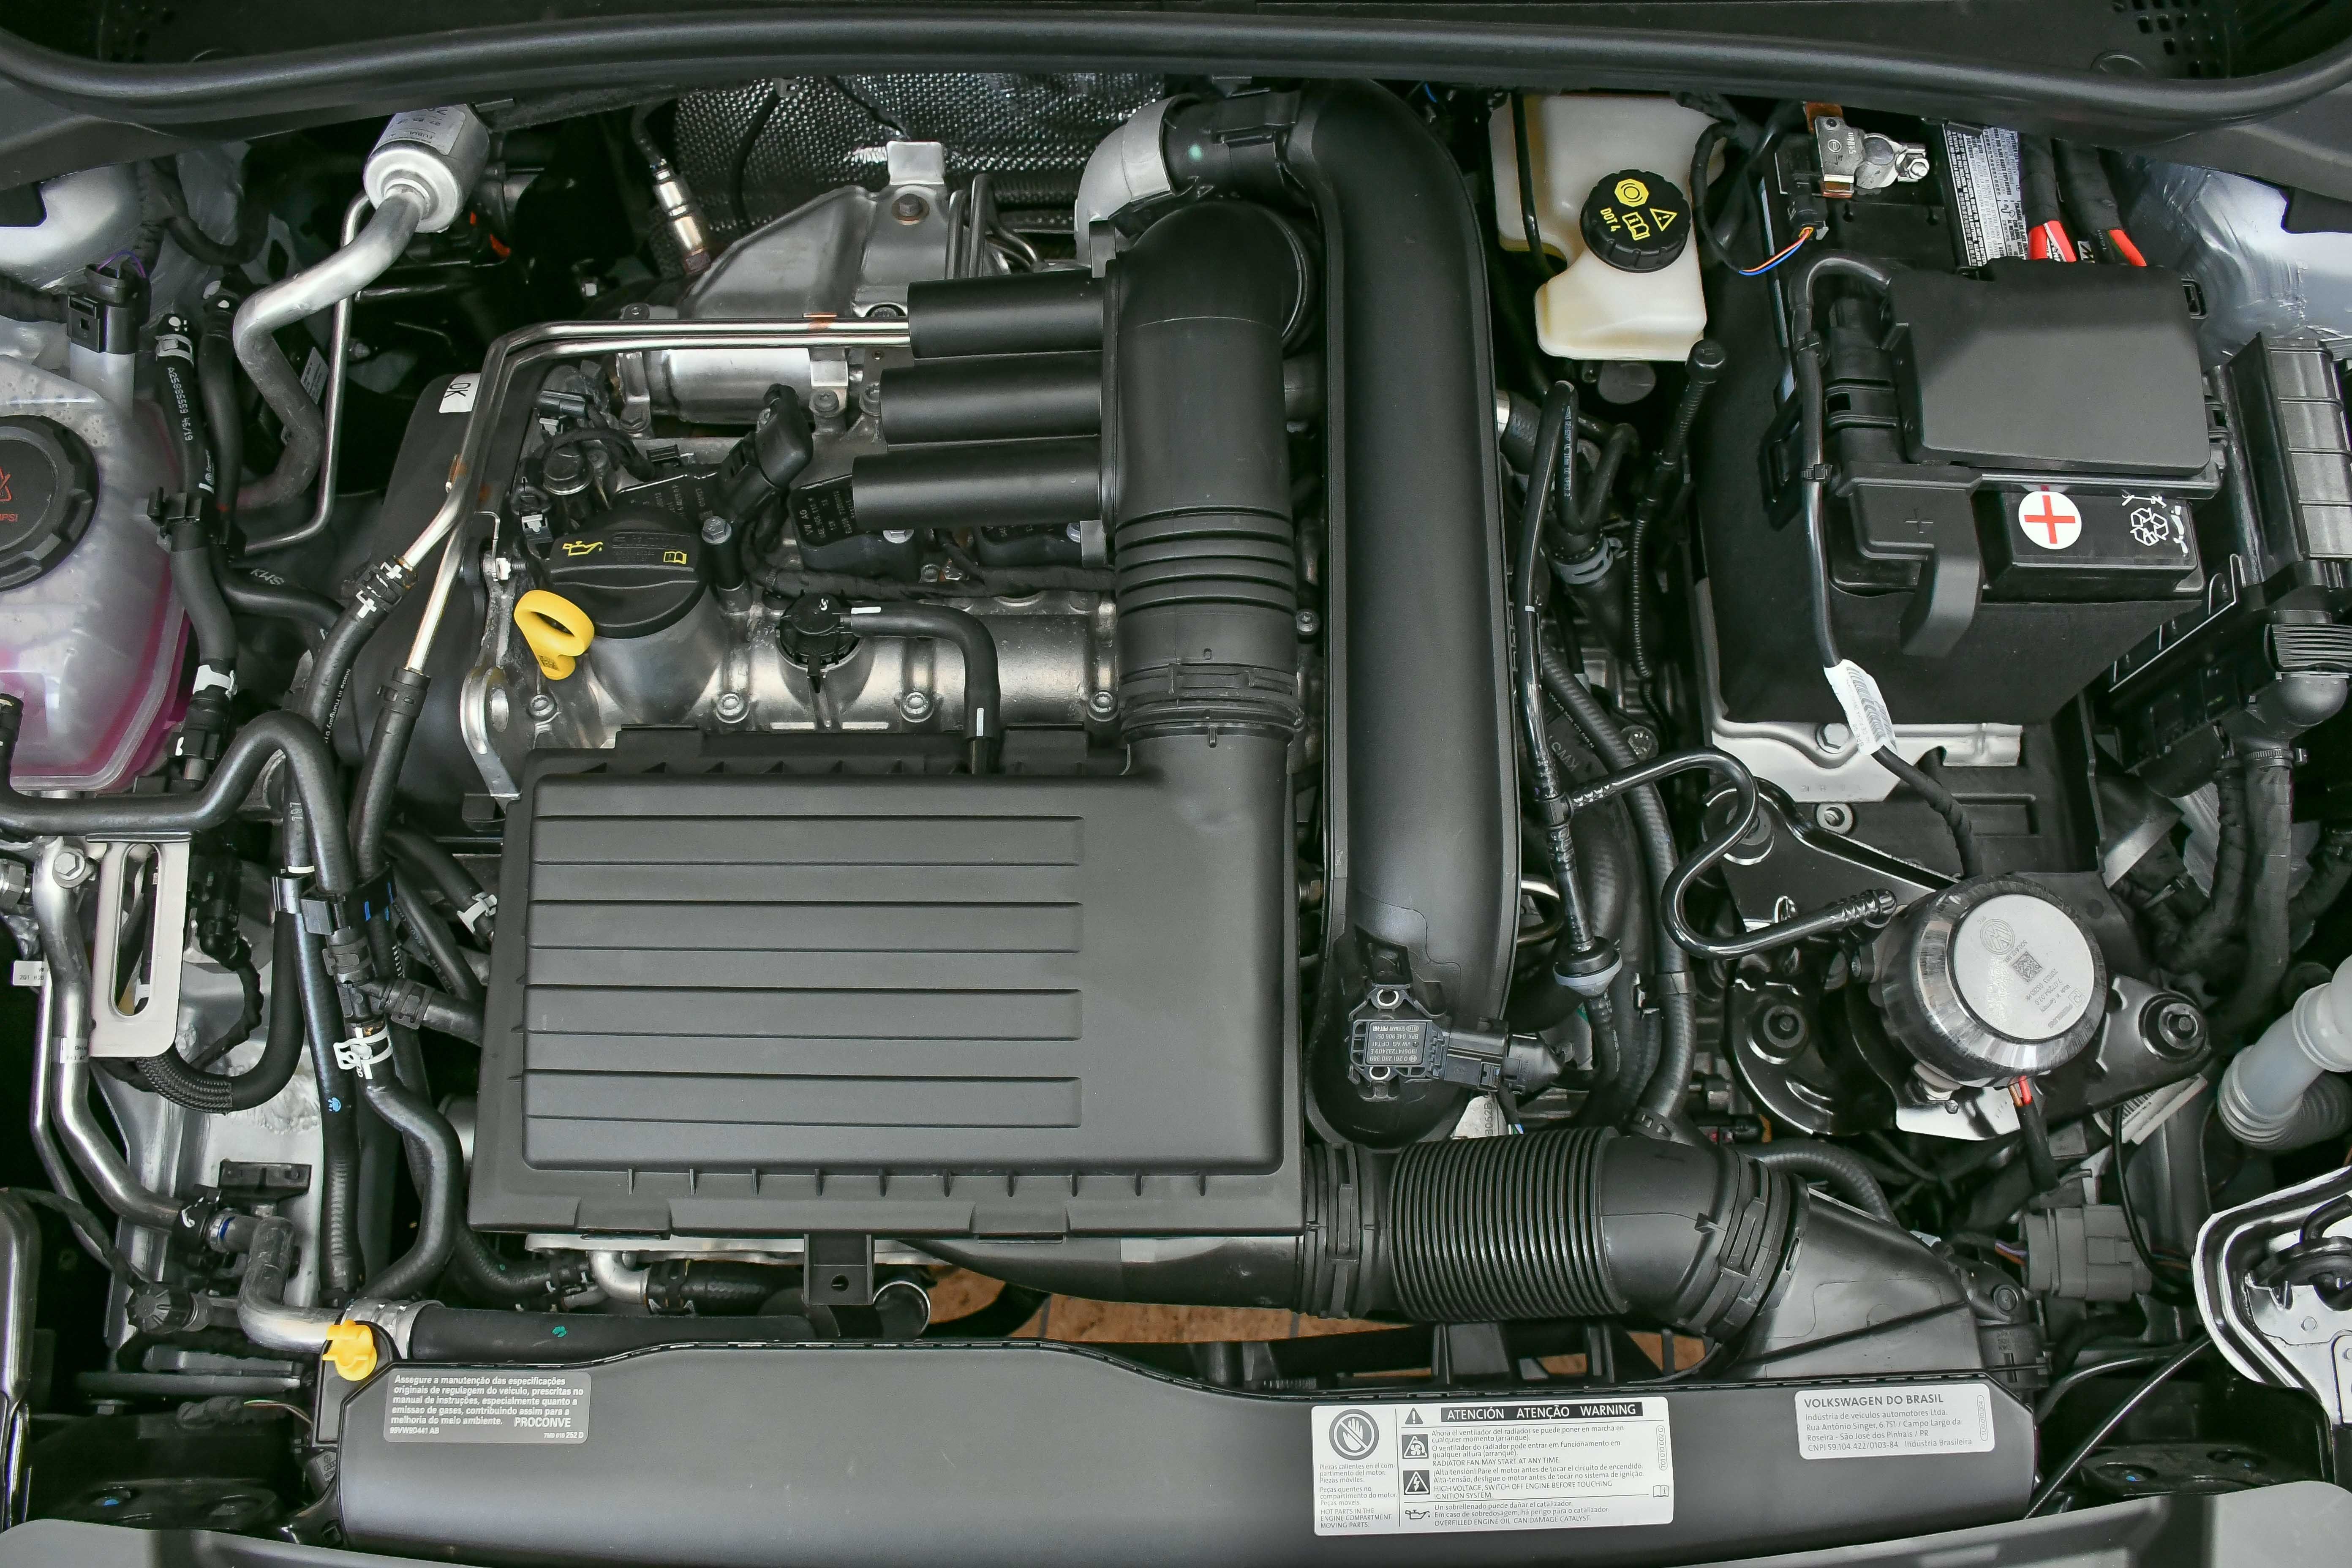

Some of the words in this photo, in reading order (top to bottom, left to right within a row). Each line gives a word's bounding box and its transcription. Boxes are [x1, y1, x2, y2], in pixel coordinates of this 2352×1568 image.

[1600, 208, 1618, 224] DOT
[444, 383, 471, 398] OK
[394, 1375, 432, 1386] Assegure
[492, 1376, 506, 1385] das
[393, 1385, 428, 1396] originais
[430, 1386, 440, 1394] de
[441, 1386, 485, 1396] regulagem
[486, 1386, 497, 1394] do
[531, 1387, 572, 1397] prescritas
[392, 1395, 423, 1404] manual
[424, 1395, 435, 1404] de
[482, 1396, 540, 1407] especialmente
[541, 1397, 570, 1407] quanto
[1804, 1396, 1883, 1408] VOLKSWAGEN
[1886, 1395, 1903, 1405] DO
[1906, 1394, 1944, 1404] BRASIL
[426, 1406, 437, 1414] de
[438, 1407, 464, 1417] gases,
[466, 1406, 517, 1415] contribuindo
[519, 1407, 543, 1415] assim
[544, 1409, 563, 1417] para
[1447, 1406, 1504, 1420] ATENCIÓN
[1516, 1405, 1570, 1419] ATENÇÃO
[1580, 1404, 1636, 1416] WARNING
[1882, 1410, 1929, 1418] automotores
[1930, 1408, 1948, 1416] Ltda.
[390, 1416, 426, 1424] melhoria
[428, 1416, 439, 1424] do
[440, 1416, 461, 1424] meio
[462, 1416, 503, 1425] ambiente.
[514, 1417, 571, 1427] PROCONVE
[1853, 1422, 1878, 1431] Singer,
[1903, 1420, 1929, 1429] Campo
[1930, 1419, 1950, 1428] Largo
[1541, 1426, 1560, 1435] puede
[1807, 1433, 1833, 1441] Roseira
[1886, 1430, 1913, 1438] Pinhais
[1432, 1436, 1461, 1444] cualquier
[1496, 1435, 1530, 1443] (arranque).
[1828, 1440, 1898, 1451] 59.104.422/0103-84
[1939, 1438, 1972, 1446] Brasileira
